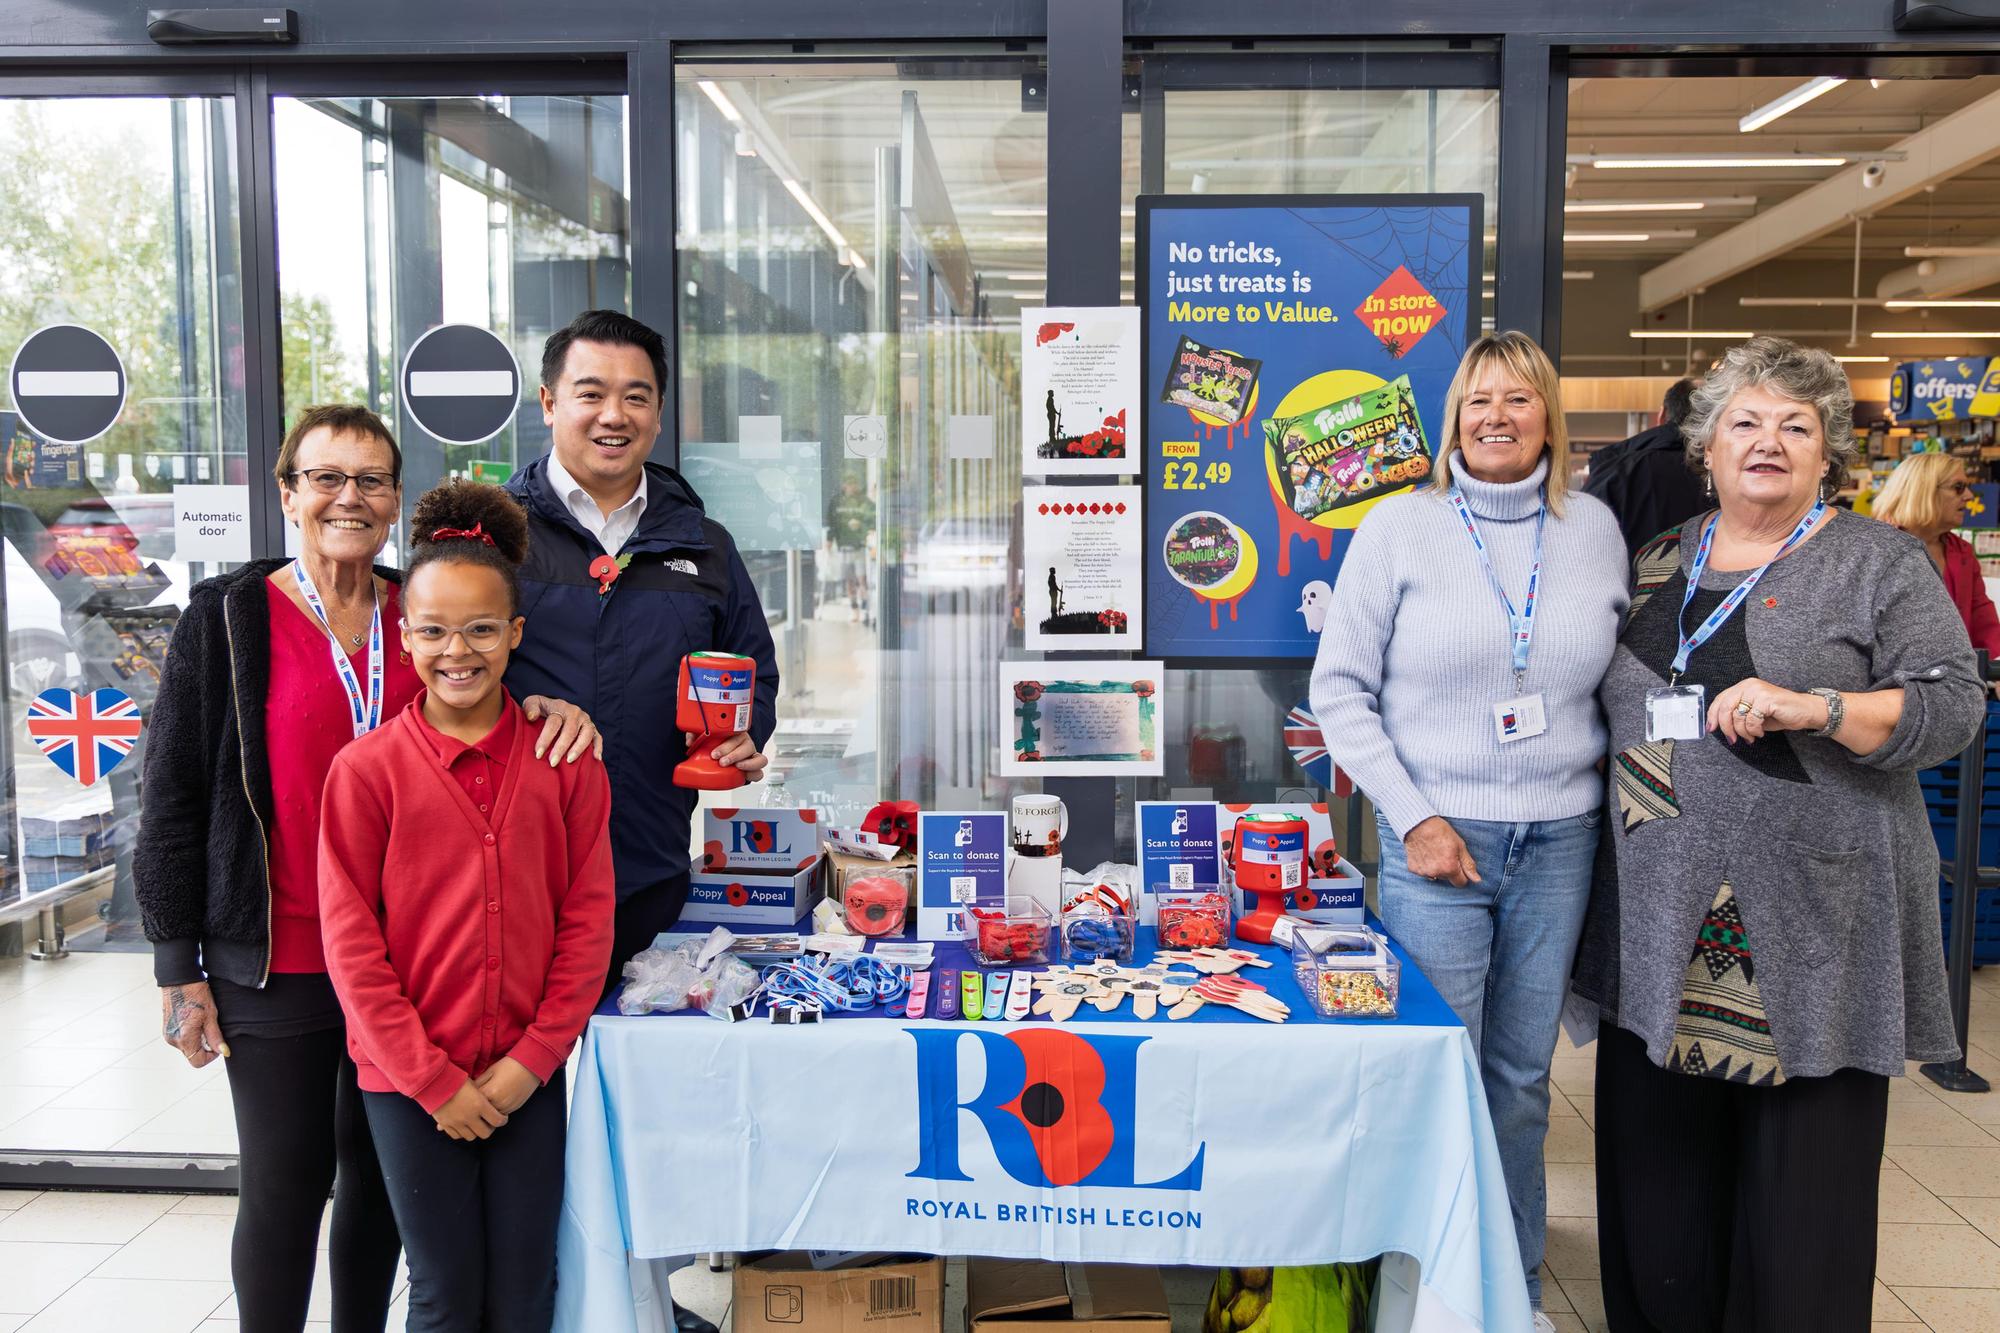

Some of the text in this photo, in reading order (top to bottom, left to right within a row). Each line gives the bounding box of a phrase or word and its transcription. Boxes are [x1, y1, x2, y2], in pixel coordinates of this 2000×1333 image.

[1168, 240, 1281, 267] No tricks,
[1167, 270, 1311, 298] just treats is
[1168, 301, 1339, 322] More to Value.
[1363, 293, 1436, 313] In store
[1372, 314, 1432, 336] now
[1914, 378, 1977, 399] offers
[1314, 396, 1364, 434] Trolli
[1163, 462, 1232, 490] £2.49
[1337, 460, 1362, 482] Trolli
[182, 512, 242, 522] Automatic
[199, 526, 226, 536] door
[1190, 534, 1216, 550] Trolli
[1147, 838, 1213, 848] Scan to donate
[928, 850, 1000, 860] Scan to donate
[692, 887, 786, 903] Poppy Appeal
[1320, 892, 1356, 904] Appeal
[906, 1198, 1201, 1228] ROYAL BRITISH LEGION
